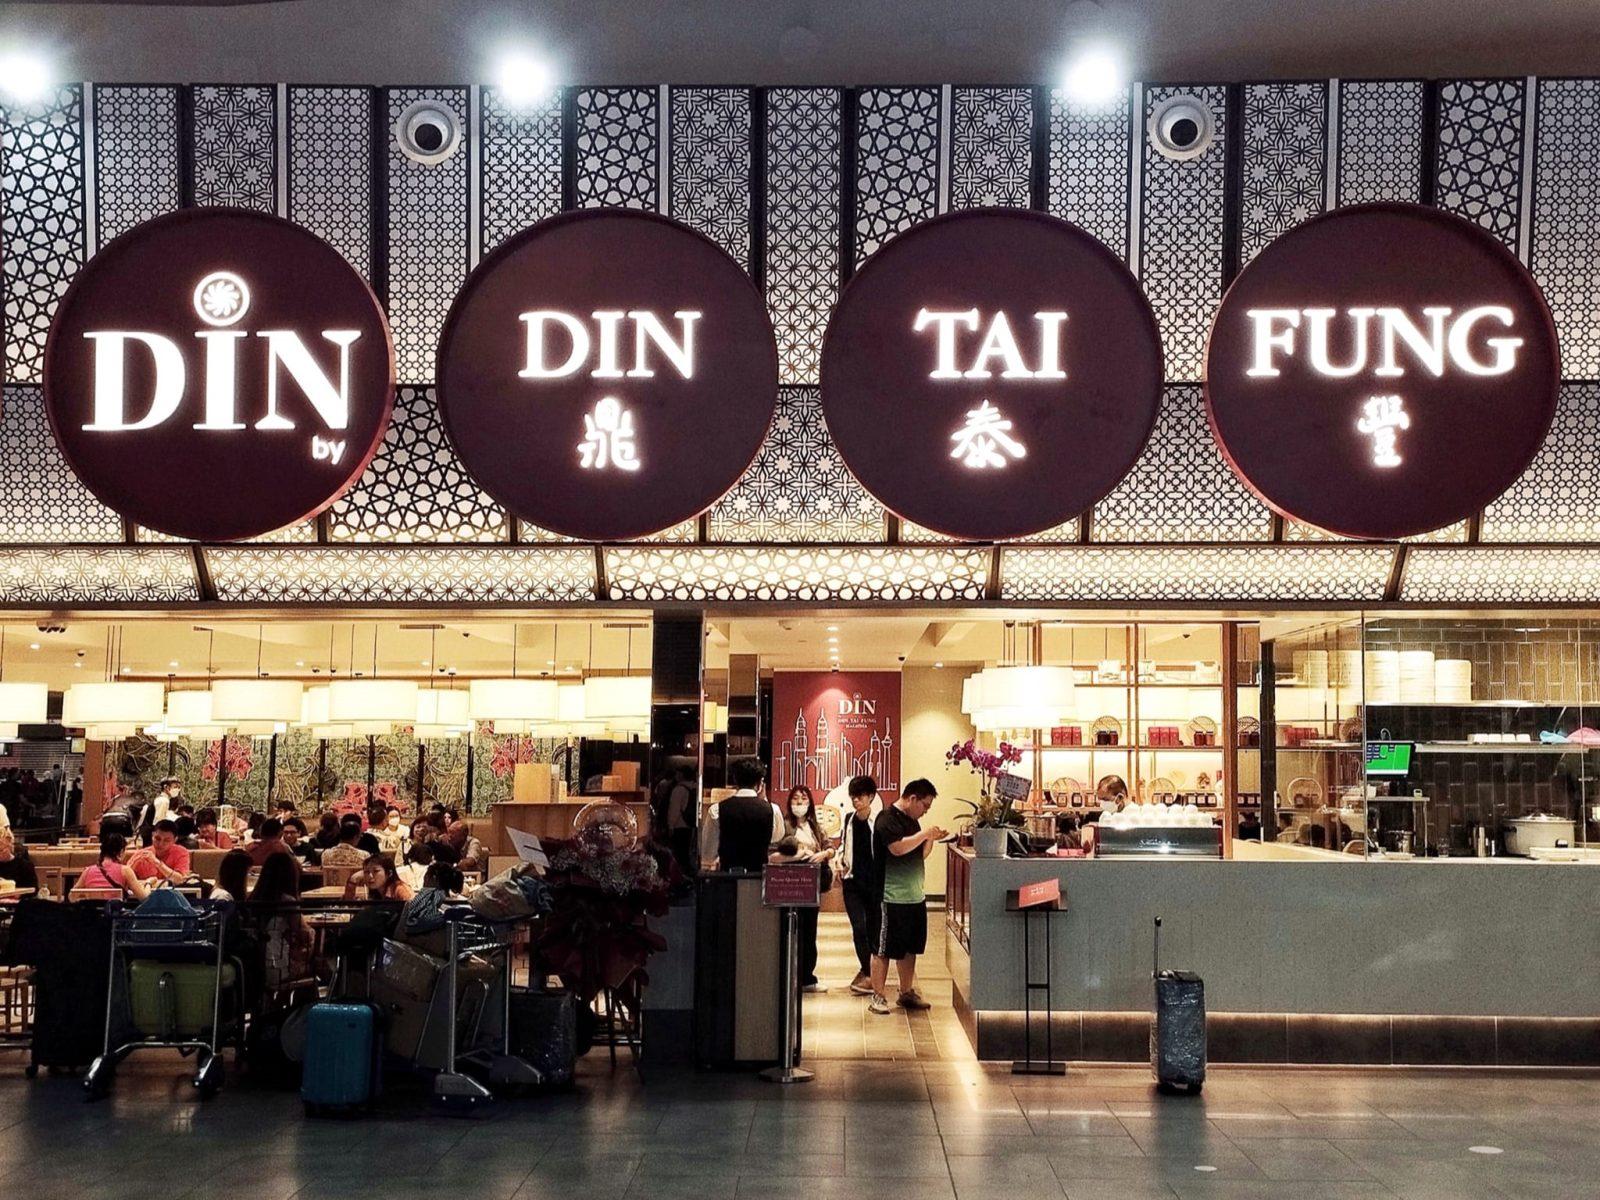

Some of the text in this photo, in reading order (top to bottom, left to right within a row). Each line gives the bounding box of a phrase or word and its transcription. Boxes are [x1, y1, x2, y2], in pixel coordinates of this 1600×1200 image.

[517, 309, 702, 380] DIN
[913, 307, 1068, 380] TAI
[1245, 305, 1524, 378] FUNG
[311, 435, 346, 465] by
[576, 396, 641, 472] 鼎
[949, 399, 1027, 470] 泰
